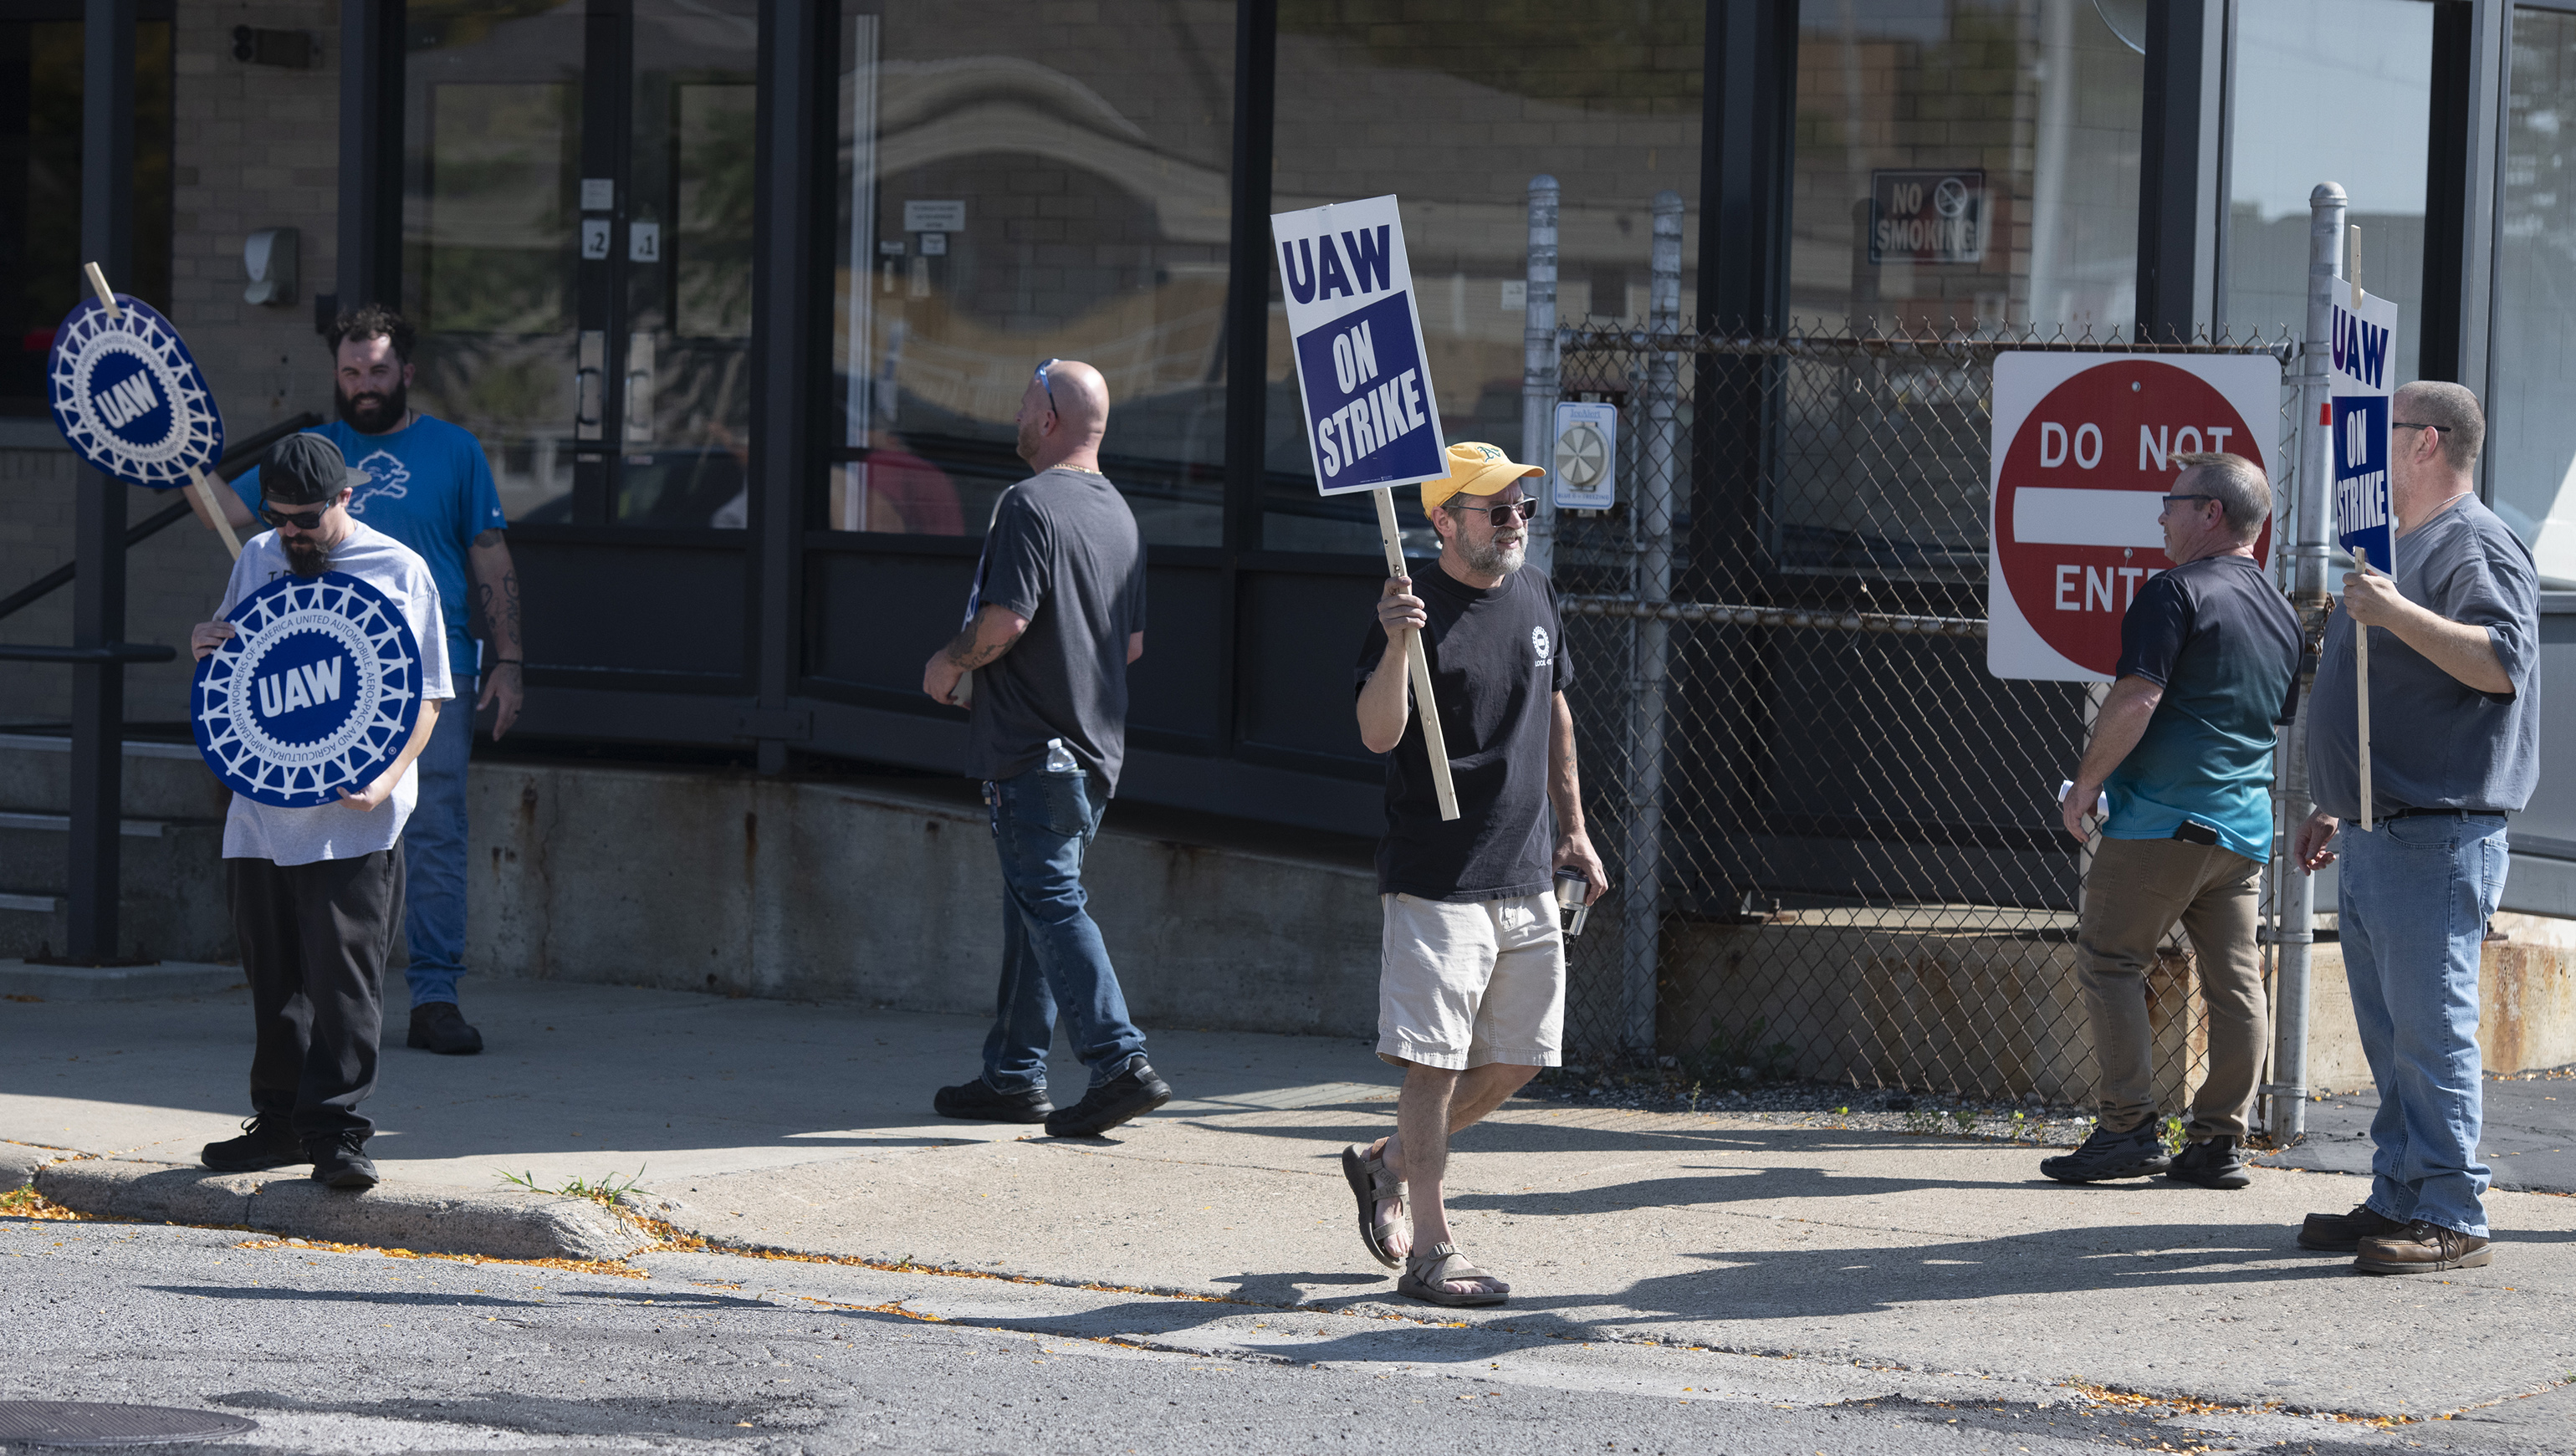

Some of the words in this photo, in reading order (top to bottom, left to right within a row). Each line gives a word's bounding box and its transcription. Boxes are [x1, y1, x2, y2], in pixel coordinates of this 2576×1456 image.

[1893, 182, 1923, 215] NO
[1877, 218, 1975, 251] SMOKING
[1282, 224, 1390, 304] UAW
[1332, 319, 1379, 395] ON
[2332, 304, 2389, 391] UAW
[94, 369, 159, 429] UAW
[1318, 367, 1426, 478] STRIKE
[2040, 421, 2103, 470] DO
[2139, 424, 2233, 472] NOT
[2347, 408, 2368, 469] ON
[2337, 469, 2386, 537] STRIKE
[2056, 564, 2167, 613] ENT
[256, 619, 294, 648] AMERICA
[295, 615, 330, 625] UNITED
[330, 619, 373, 671] AUTOMOBILE,
[245, 646, 256, 661] OF
[232, 662, 248, 708] WORKERS
[258, 655, 341, 718] UAW
[354, 672, 376, 728] AEROSPACE
[233, 709, 267, 753] IMPLEMENT
[268, 742, 336, 762] AGRICULTURAL
[338, 726, 356, 746] AND
